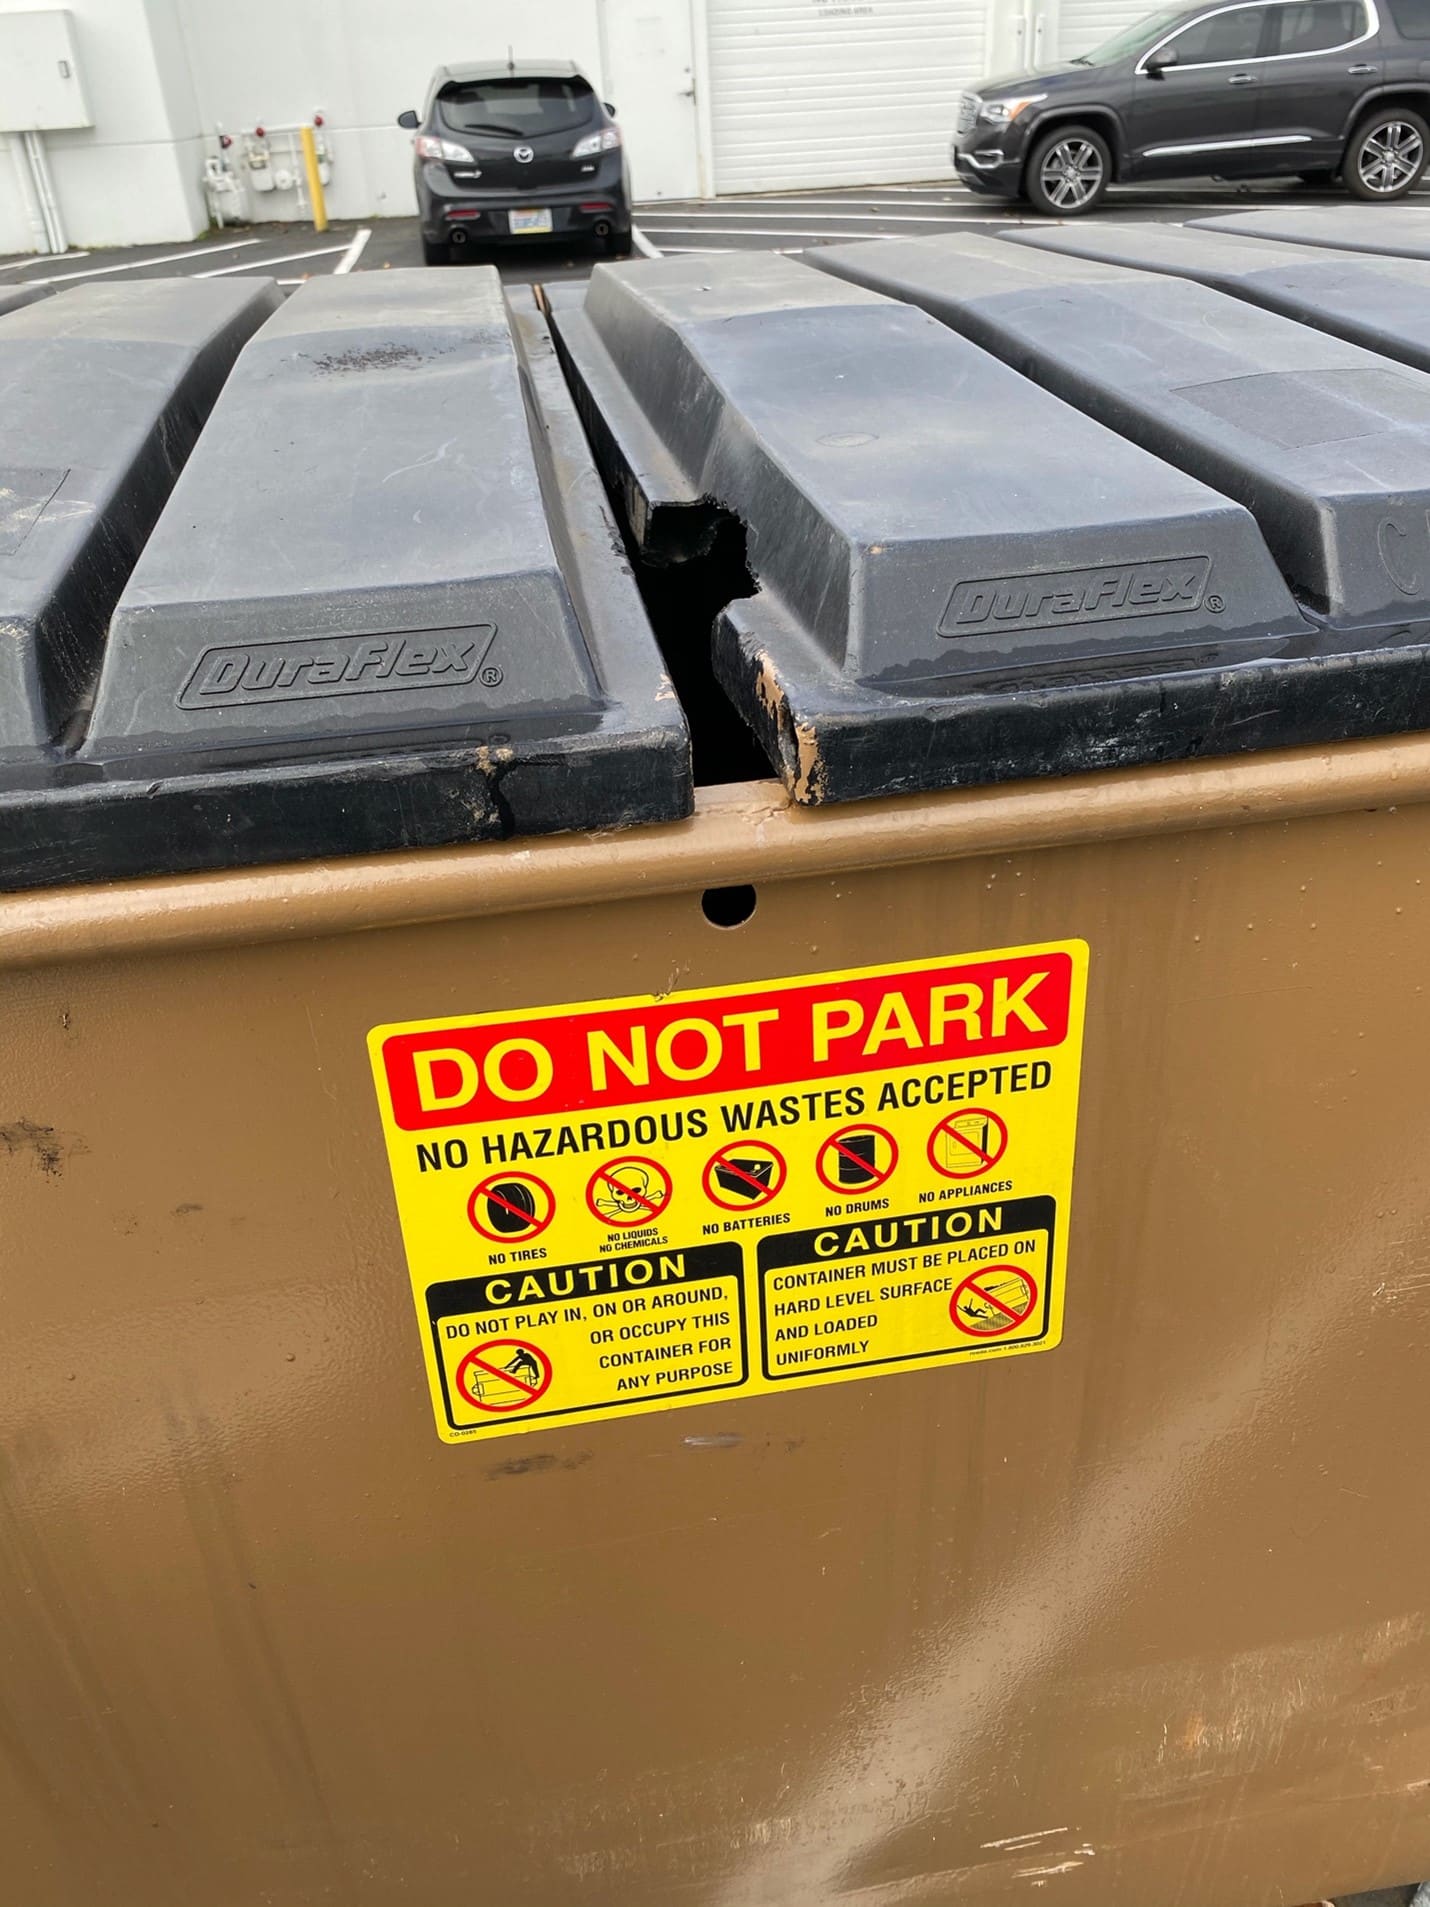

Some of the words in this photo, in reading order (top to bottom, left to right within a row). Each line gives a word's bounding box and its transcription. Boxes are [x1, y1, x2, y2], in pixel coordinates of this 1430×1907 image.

[413, 1038, 553, 1112] DO
[587, 1009, 779, 1092] NOT
[812, 972, 1050, 1063] PARK
[416, 1139, 468, 1172] NO
[482, 1109, 708, 1165] HAZARDOUS
[721, 1087, 865, 1133] WASTES
[877, 1061, 1051, 1111] ACCEPTED
[919, 1191, 936, 1203] NO
[938, 1180, 1013, 1201] APPLIANCES
[825, 1205, 843, 1217] NO
[845, 1198, 889, 1214] DRUMS
[607, 1232, 621, 1242] NO
[622, 1228, 658, 1240] LIQUIDS
[702, 1223, 721, 1235] NO
[723, 1213, 790, 1233] BATTERIES
[814, 1207, 1003, 1257] CAUTION
[489, 1253, 510, 1265] NO
[512, 1248, 547, 1262] TIRES
[600, 1243, 612, 1253] NO
[614, 1236, 668, 1251] CHEMICALS
[485, 1254, 685, 1305] CAUTION
[773, 1265, 866, 1291] CONTAINER
[871, 1256, 919, 1275] MUST
[923, 1253, 942, 1268] BE
[947, 1244, 1008, 1265] PLACED
[1014, 1239, 1036, 1253] ON
[774, 1298, 820, 1316] HARD
[826, 1290, 875, 1309] LEVEL
[879, 1277, 952, 1300] SURFACE
[446, 1323, 470, 1339] DO
[476, 1318, 510, 1334] NOT
[515, 1311, 559, 1329] PLAY
[565, 1307, 587, 1322] IN,
[593, 1303, 620, 1318] ON
[622, 1298, 646, 1313] OR
[651, 1286, 728, 1309] AROUND,
[590, 1330, 613, 1344] OR
[620, 1318, 687, 1340] OCCUPY
[692, 1311, 730, 1328] THIS
[775, 1324, 809, 1341] AND
[813, 1314, 878, 1335] LOADED
[599, 1344, 693, 1369] CONTAINER
[700, 1337, 732, 1352] FOR
[776, 1340, 870, 1366] UNIFORMLY
[616, 1375, 650, 1391] ANY
[656, 1361, 733, 1384] PURPOSE
